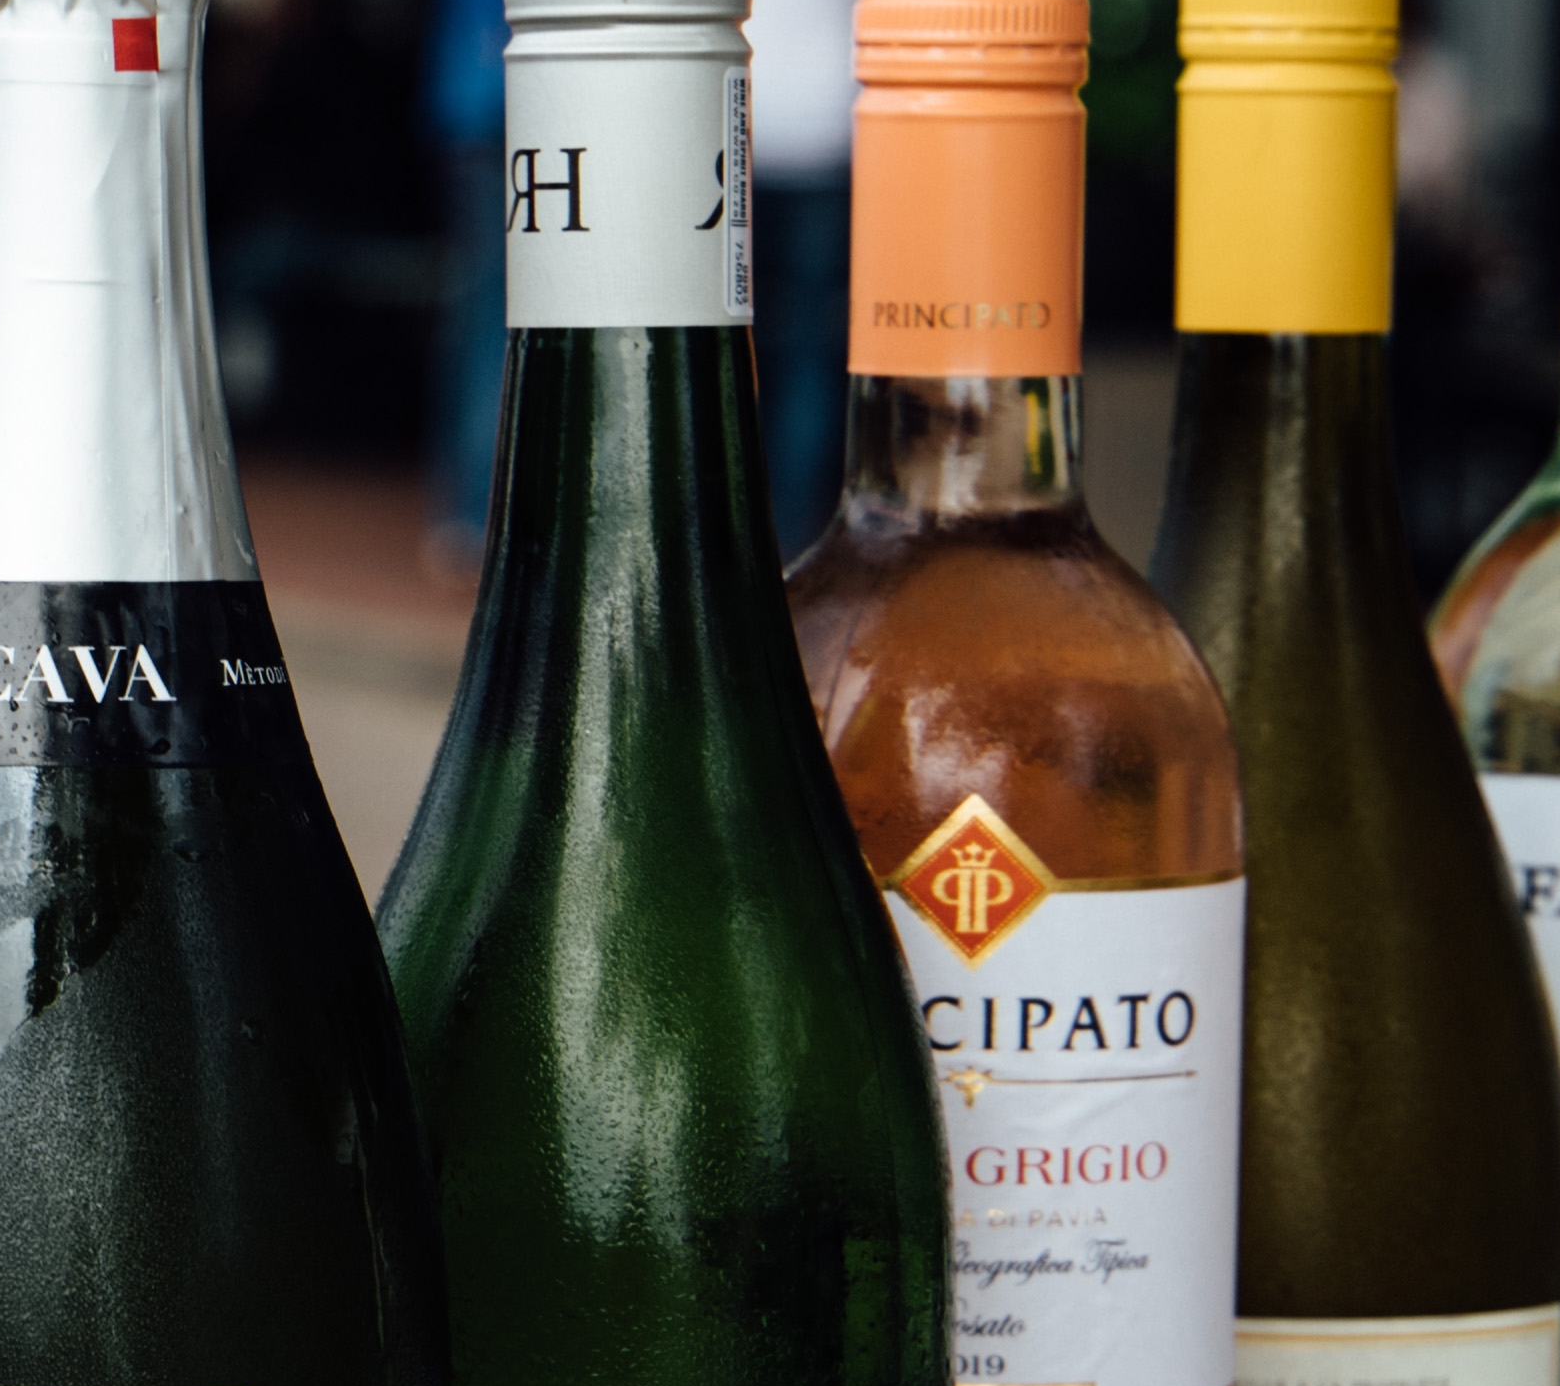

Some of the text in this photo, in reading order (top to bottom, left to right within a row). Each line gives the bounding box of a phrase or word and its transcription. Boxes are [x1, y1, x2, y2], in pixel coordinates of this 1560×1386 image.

[873, 301, 1052, 330] PRINCIPATO
[922, 989, 1196, 1053] CIPATO
[965, 1141, 1168, 1187] GRIGIO
[1081, 1238, 1150, 1285] Tipica
[946, 1297, 1027, 1337] osato
[952, 1354, 1006, 1377] 019
